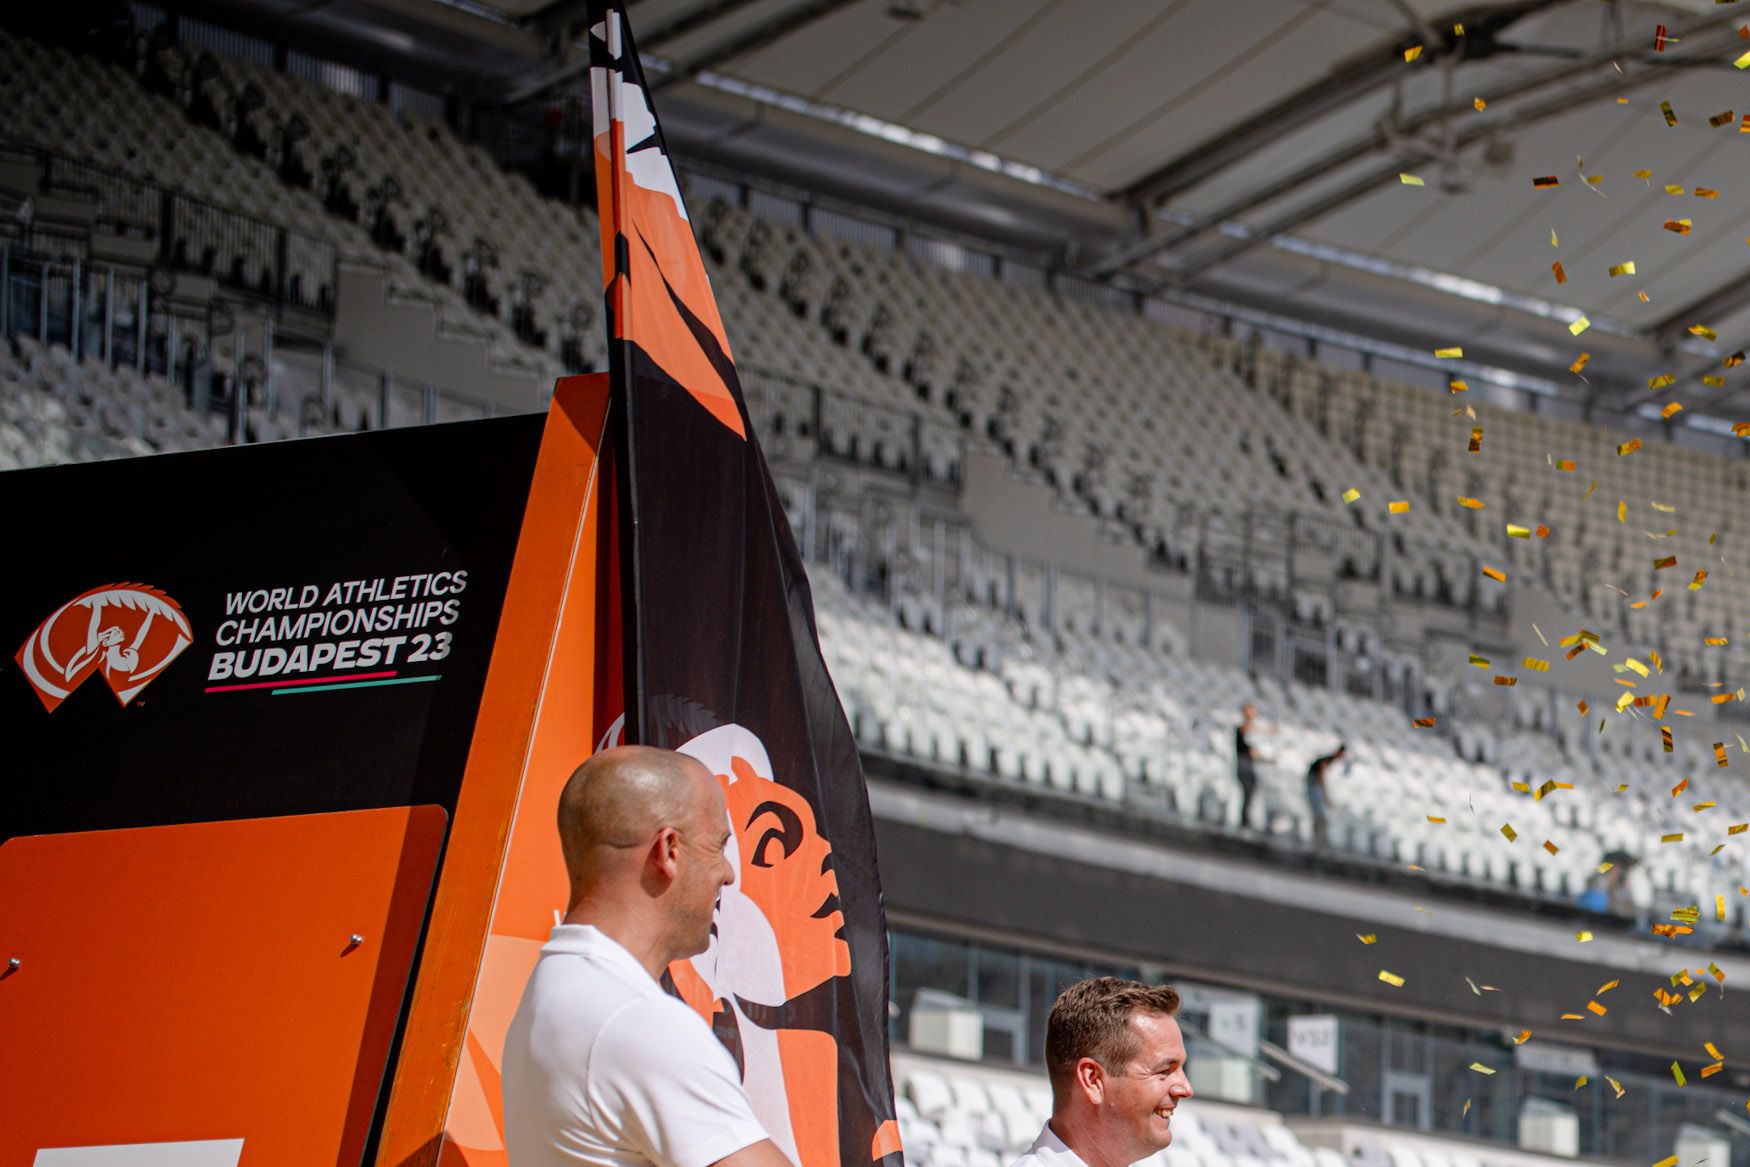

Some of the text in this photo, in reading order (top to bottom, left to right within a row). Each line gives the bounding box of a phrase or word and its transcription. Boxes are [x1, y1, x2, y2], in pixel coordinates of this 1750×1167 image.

[226, 570, 468, 615] WORLD ATHLETICS
[215, 599, 461, 646] CHAMPIONSHIPS
[207, 631, 453, 681] BUDAPEST 23
